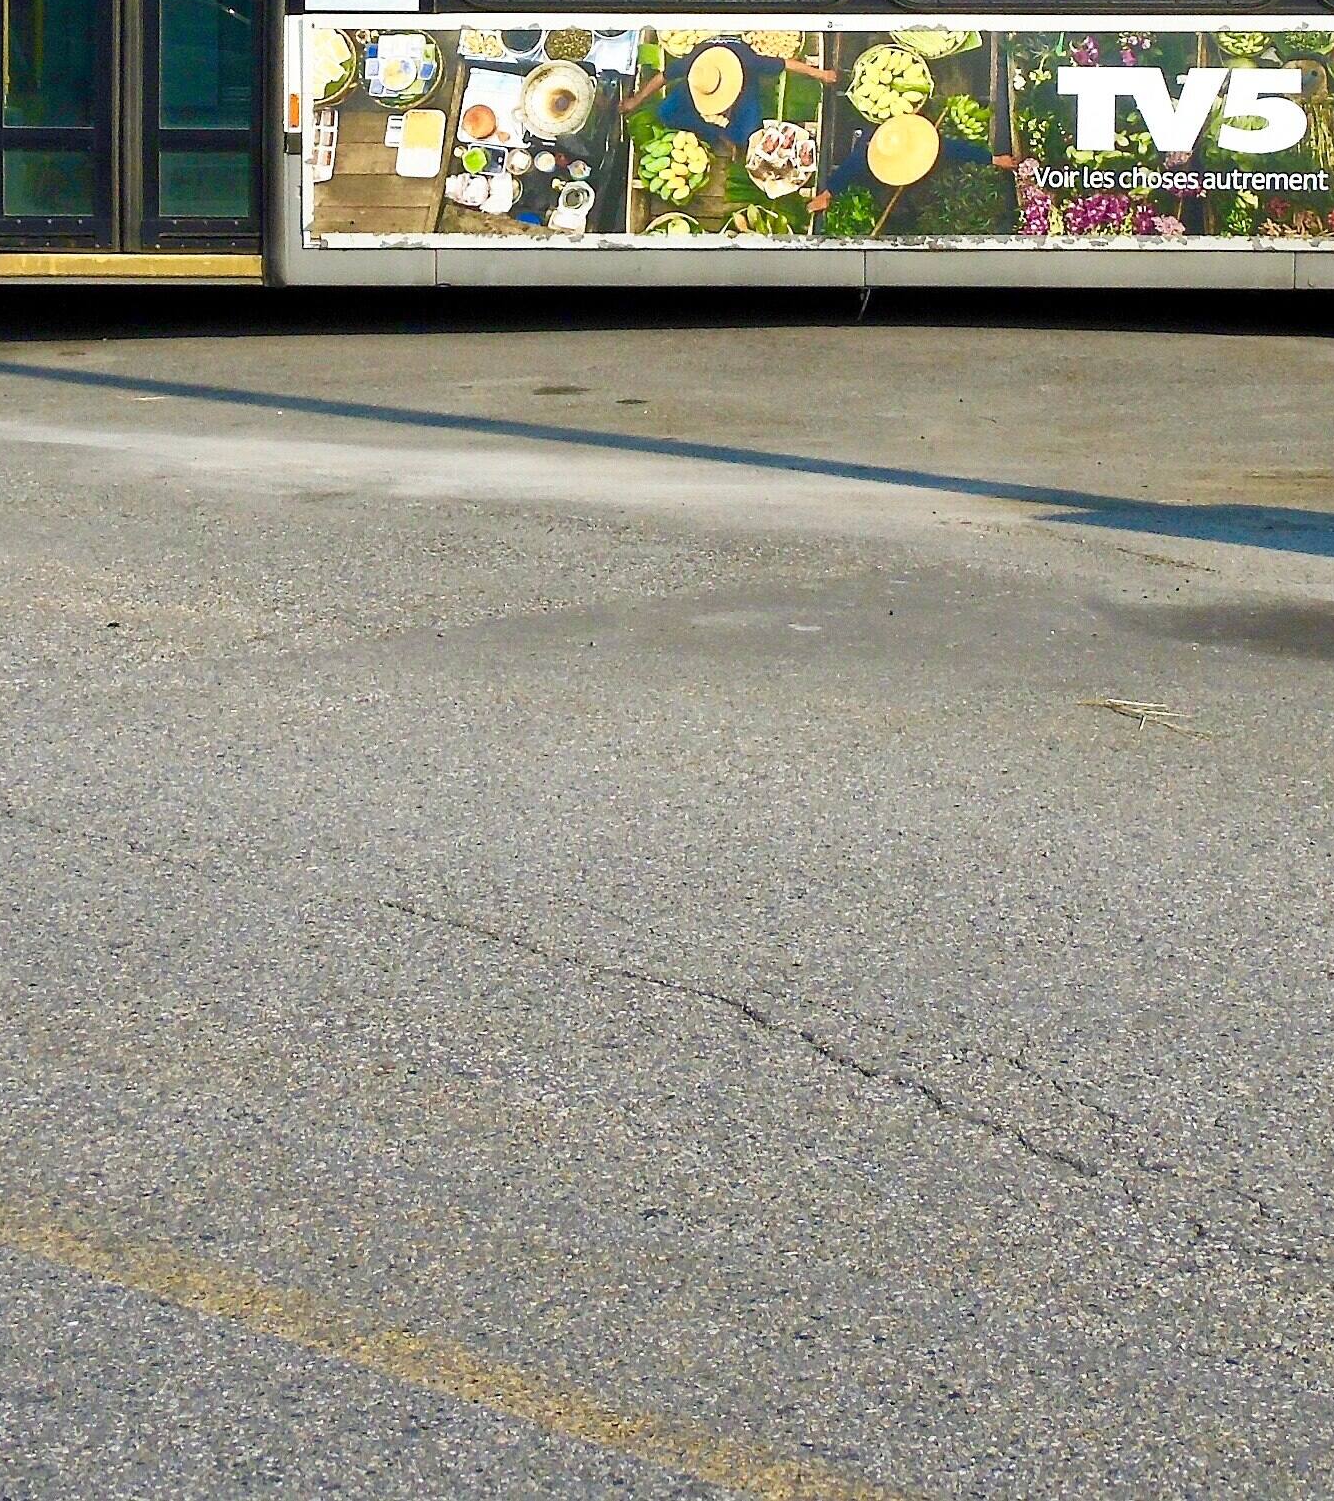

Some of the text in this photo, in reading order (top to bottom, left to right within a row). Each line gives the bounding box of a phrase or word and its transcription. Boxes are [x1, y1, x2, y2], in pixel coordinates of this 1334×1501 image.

[1057, 66, 1308, 153] TV5
[1033, 167, 1329, 191] Voir les choses autrement
